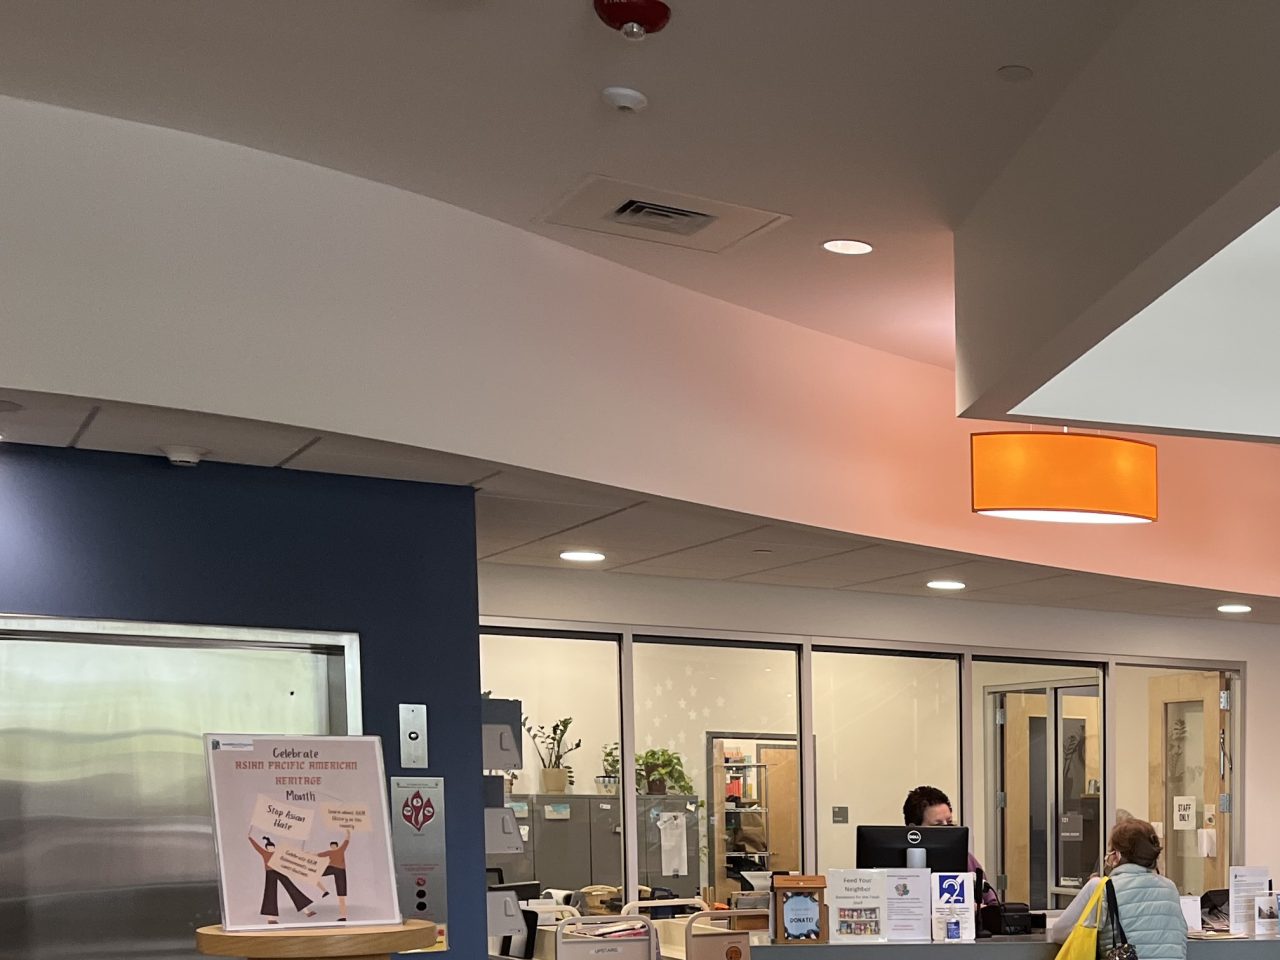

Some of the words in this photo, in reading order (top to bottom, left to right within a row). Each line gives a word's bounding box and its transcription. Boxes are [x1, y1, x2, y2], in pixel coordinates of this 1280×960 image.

[272, 747, 319, 759] Celebrate
[235, 761, 264, 770] ASIAN
[268, 761, 305, 770] PACIFIC
[309, 761, 358, 770] AMERICAN
[275, 776, 322, 786] HERITAGE
[286, 790, 316, 802] Month
[1178, 803, 1192, 813] STAFF
[267, 805, 284, 818] Stop
[286, 810, 306, 823] Asian
[1179, 813, 1190, 823] ONLY
[273, 820, 293, 831] Hate
